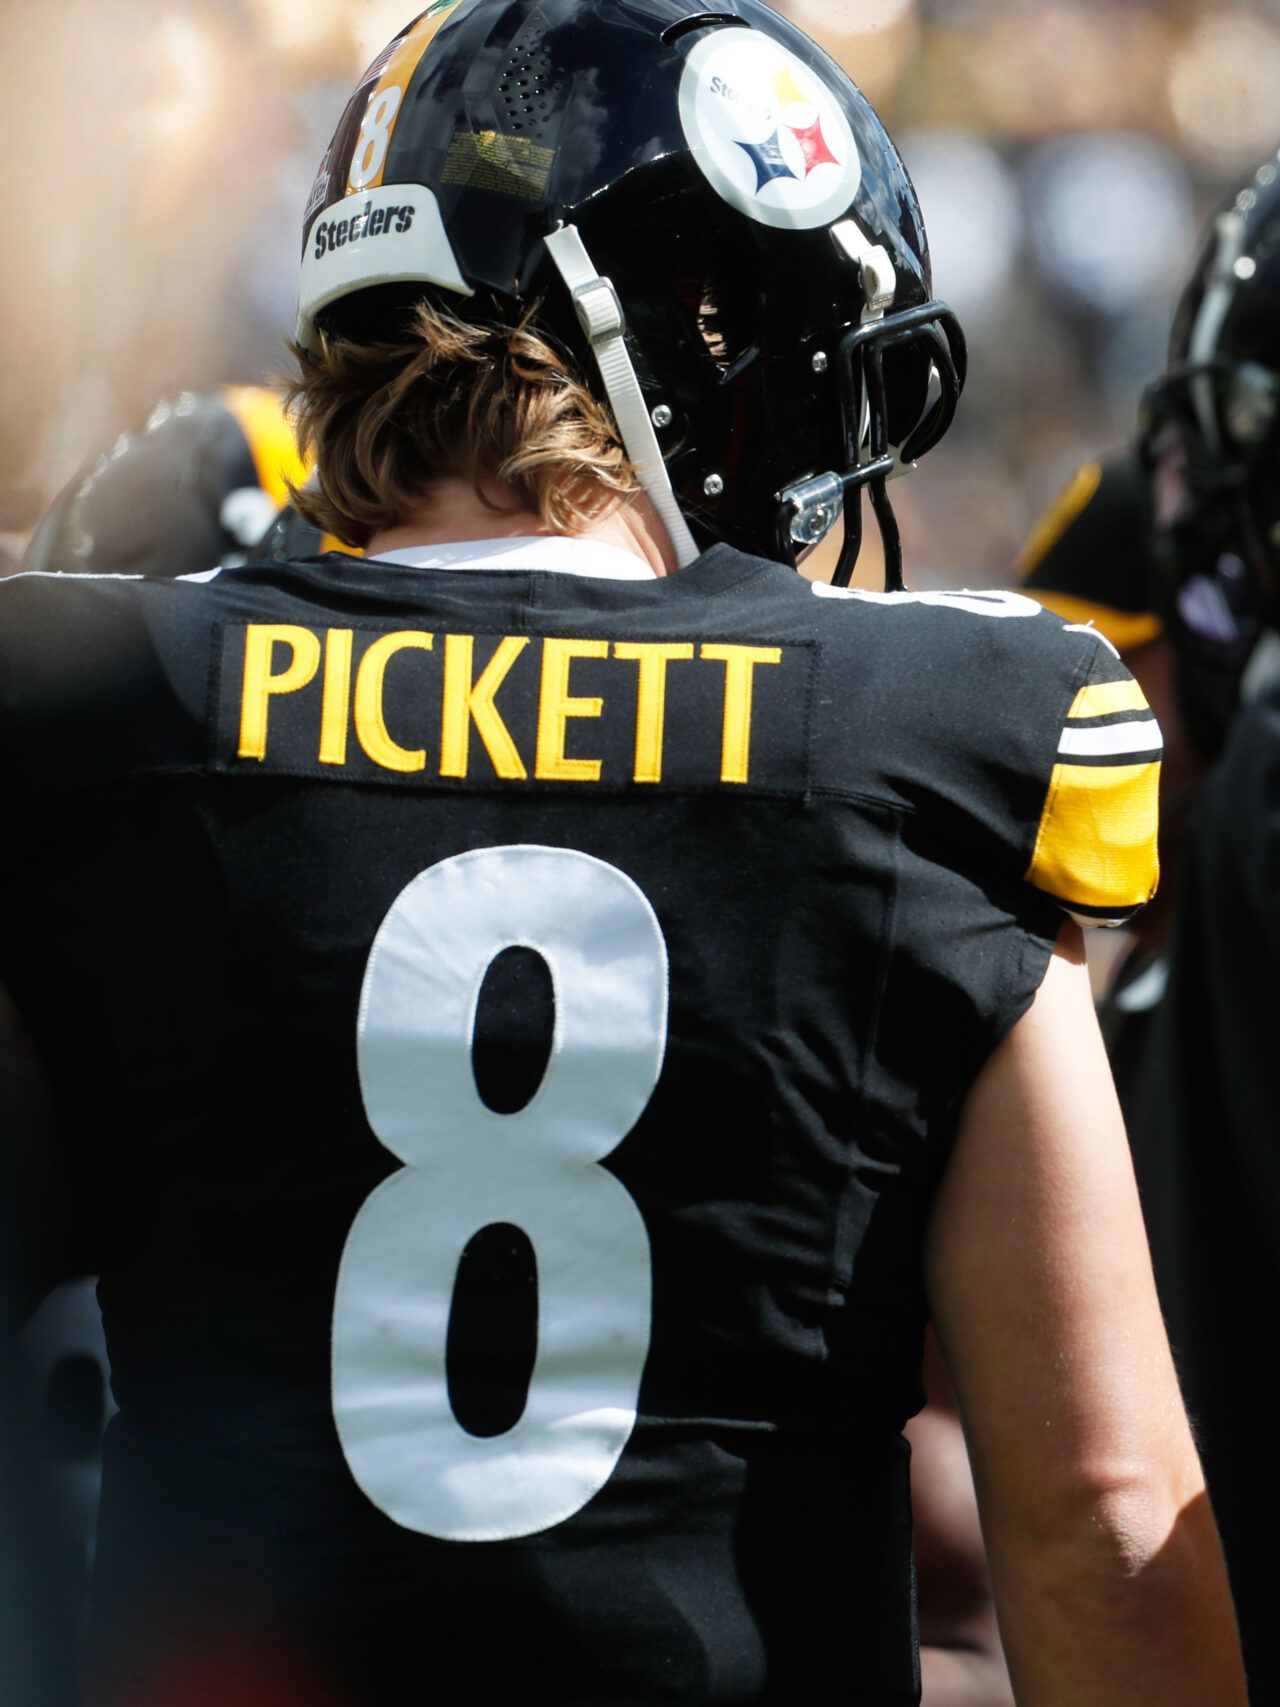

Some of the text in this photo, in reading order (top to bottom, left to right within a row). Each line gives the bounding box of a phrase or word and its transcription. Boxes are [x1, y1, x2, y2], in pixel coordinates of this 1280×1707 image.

[349, 85, 402, 189] 8
[314, 200, 416, 261] Steelers
[237, 623, 783, 784] PICKETT
[330, 843, 671, 1543] 8
